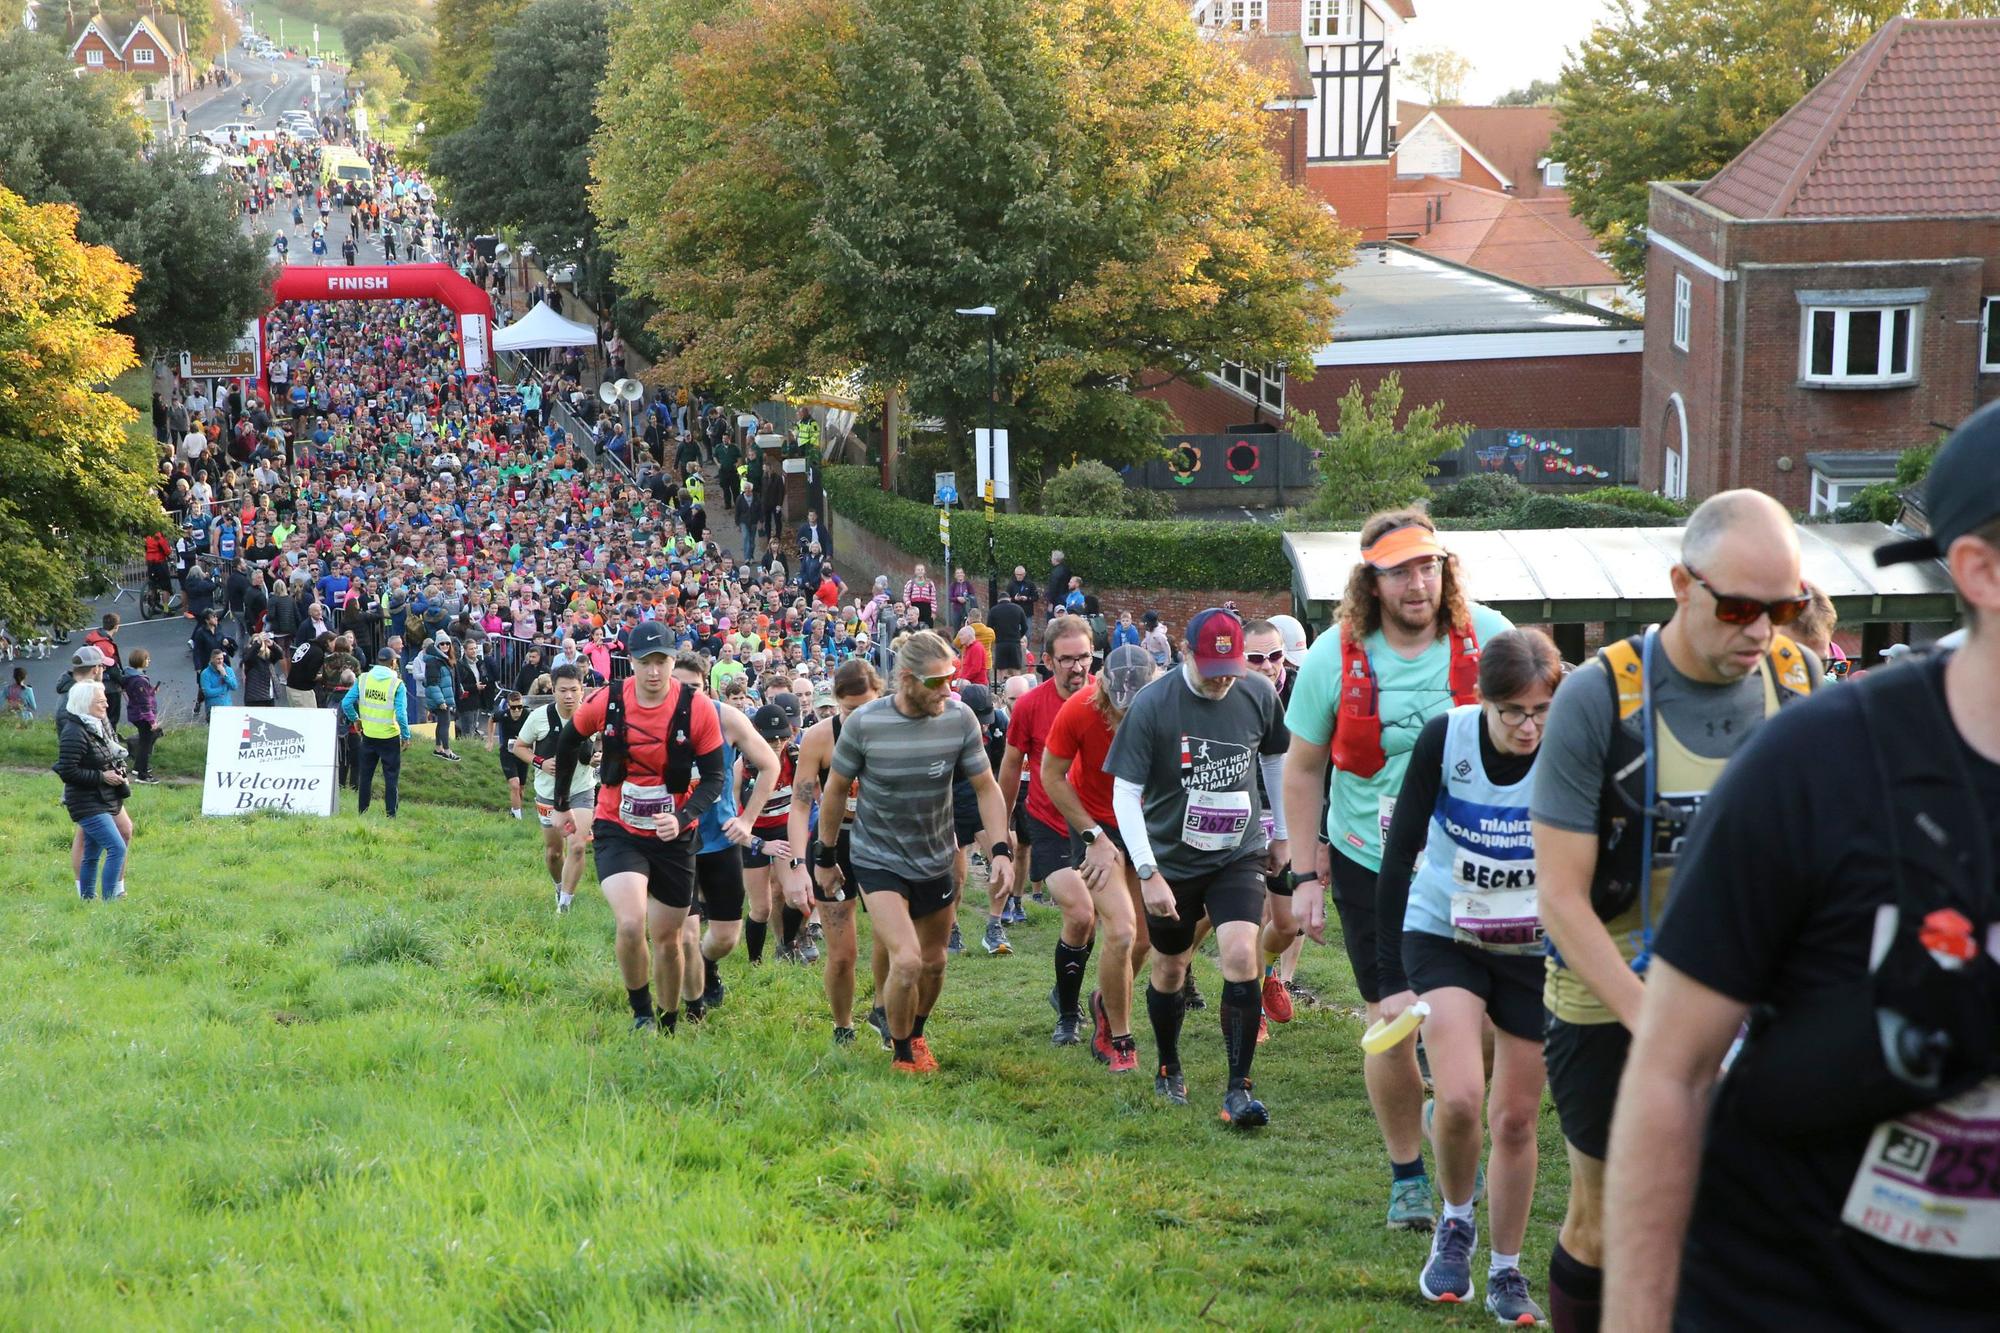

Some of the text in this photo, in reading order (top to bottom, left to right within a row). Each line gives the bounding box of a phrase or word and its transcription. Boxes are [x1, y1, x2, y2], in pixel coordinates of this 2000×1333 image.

[328, 276, 388, 290] FINISH
[365, 688, 387, 702] MARSHAL
[238, 744, 305, 760] MARATHON
[251, 740, 284, 749] BEACHY
[1193, 749, 1251, 773] BEACHY HEAD
[217, 771, 320, 791] Welcome
[1181, 760, 1250, 788] MARATHON
[1210, 777, 1232, 790] HALF
[236, 791, 296, 810] Back
[1200, 816, 1234, 832] 2672
[1480, 818, 1532, 834] THANET
[1462, 861, 1536, 889] BECKY
[1928, 1144, 2000, 1196] 25
